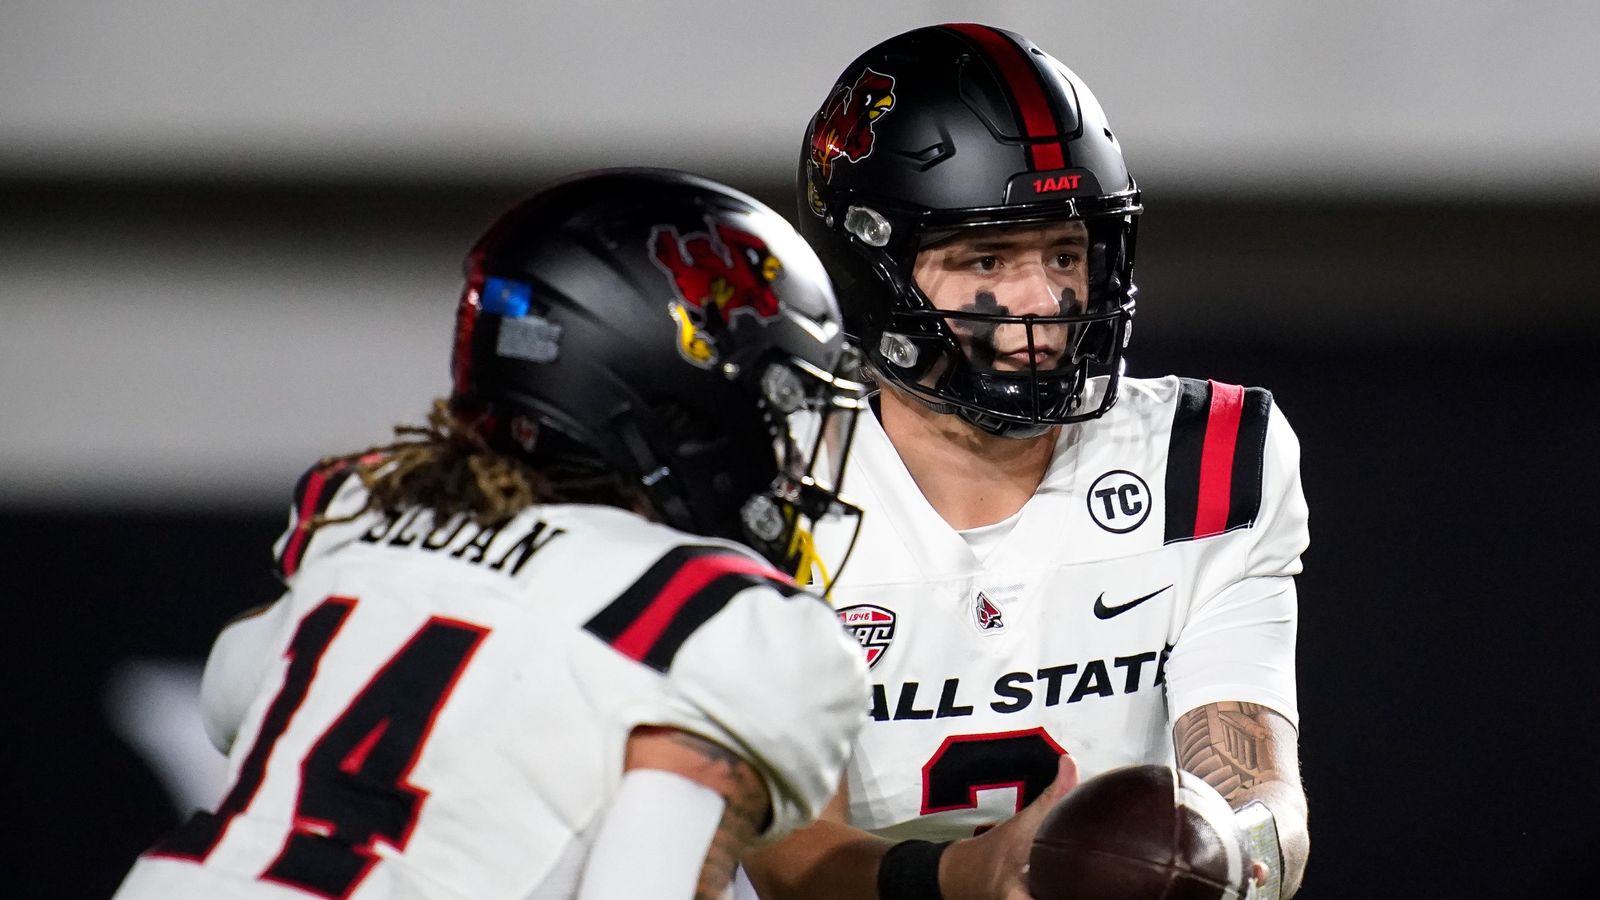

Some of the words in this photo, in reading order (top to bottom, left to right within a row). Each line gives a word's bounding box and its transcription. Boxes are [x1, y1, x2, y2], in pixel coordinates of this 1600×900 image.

[1033, 175, 1082, 193] 1AAT
[1094, 483, 1143, 520] TC
[848, 612, 870, 622] 1946
[848, 626, 893, 646] AC
[867, 678, 974, 721] ALL
[142, 596, 493, 900] 14
